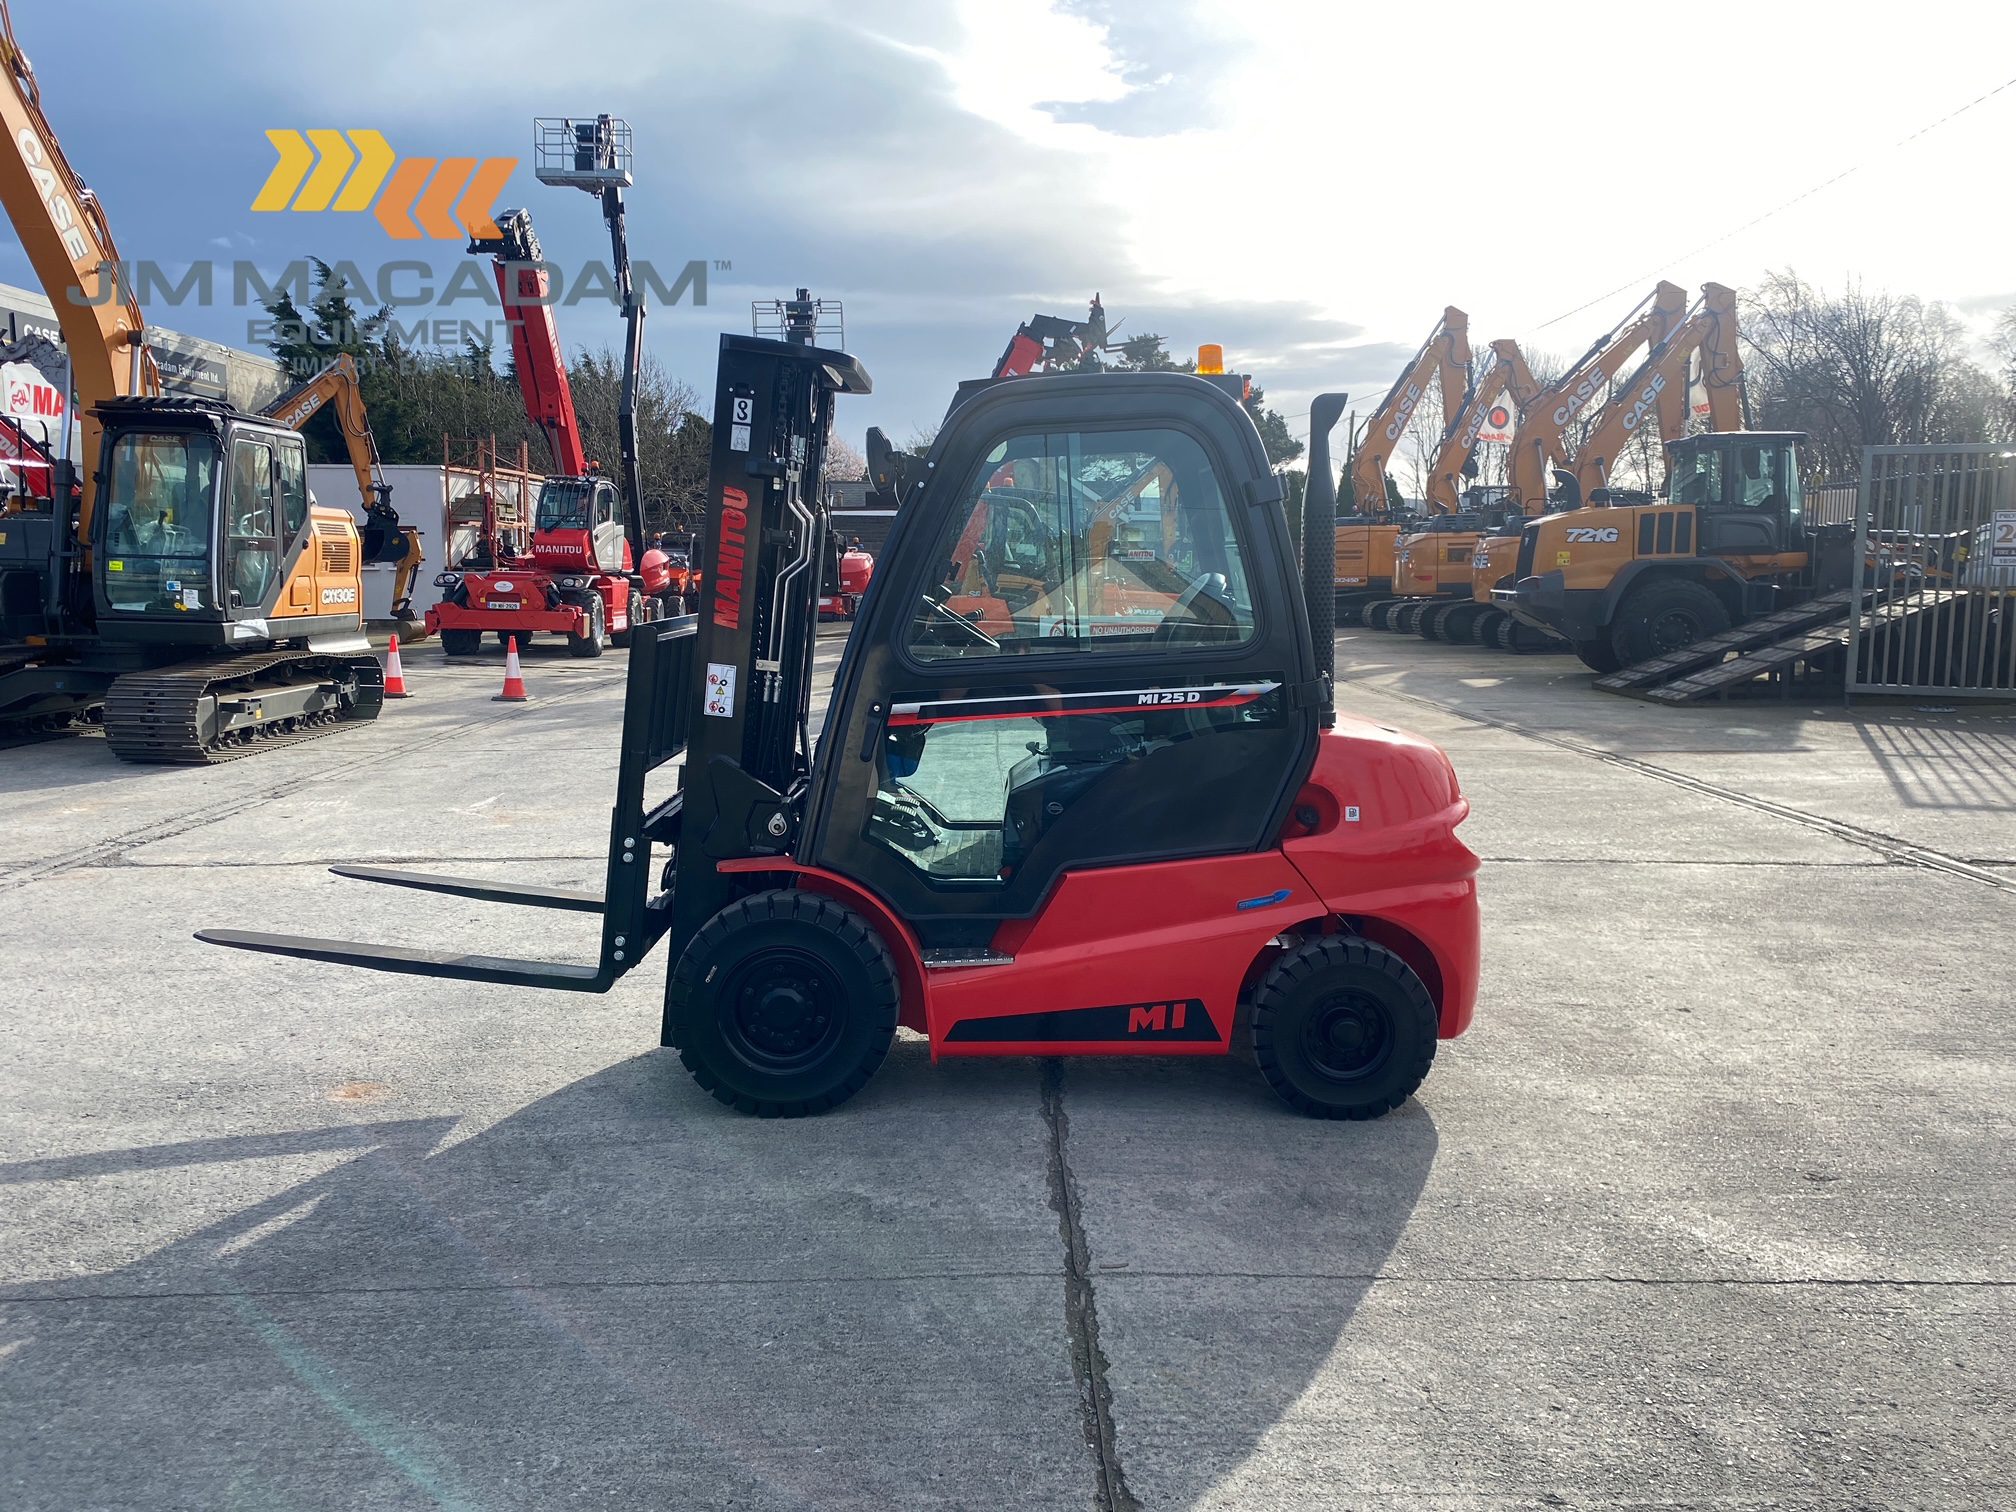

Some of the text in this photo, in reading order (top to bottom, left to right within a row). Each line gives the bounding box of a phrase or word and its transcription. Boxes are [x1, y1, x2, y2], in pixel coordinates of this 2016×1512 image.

[17, 128, 89, 262] CASE
[284, 393, 321, 428] CASE
[1384, 383, 1421, 441] CASE
[1552, 366, 1606, 426] CASE
[1622, 373, 1666, 430] CASE
[1461, 402, 1488, 449] CASE
[1108, 492, 1135, 519] CASE
[535, 544, 583, 554] MANITOU
[1565, 527, 1619, 543] 721G
[713, 485, 749, 630] MANITOU
[321, 588, 356, 604] CX130E
[1092, 625, 1156, 634] NO UNAUTHORISED
